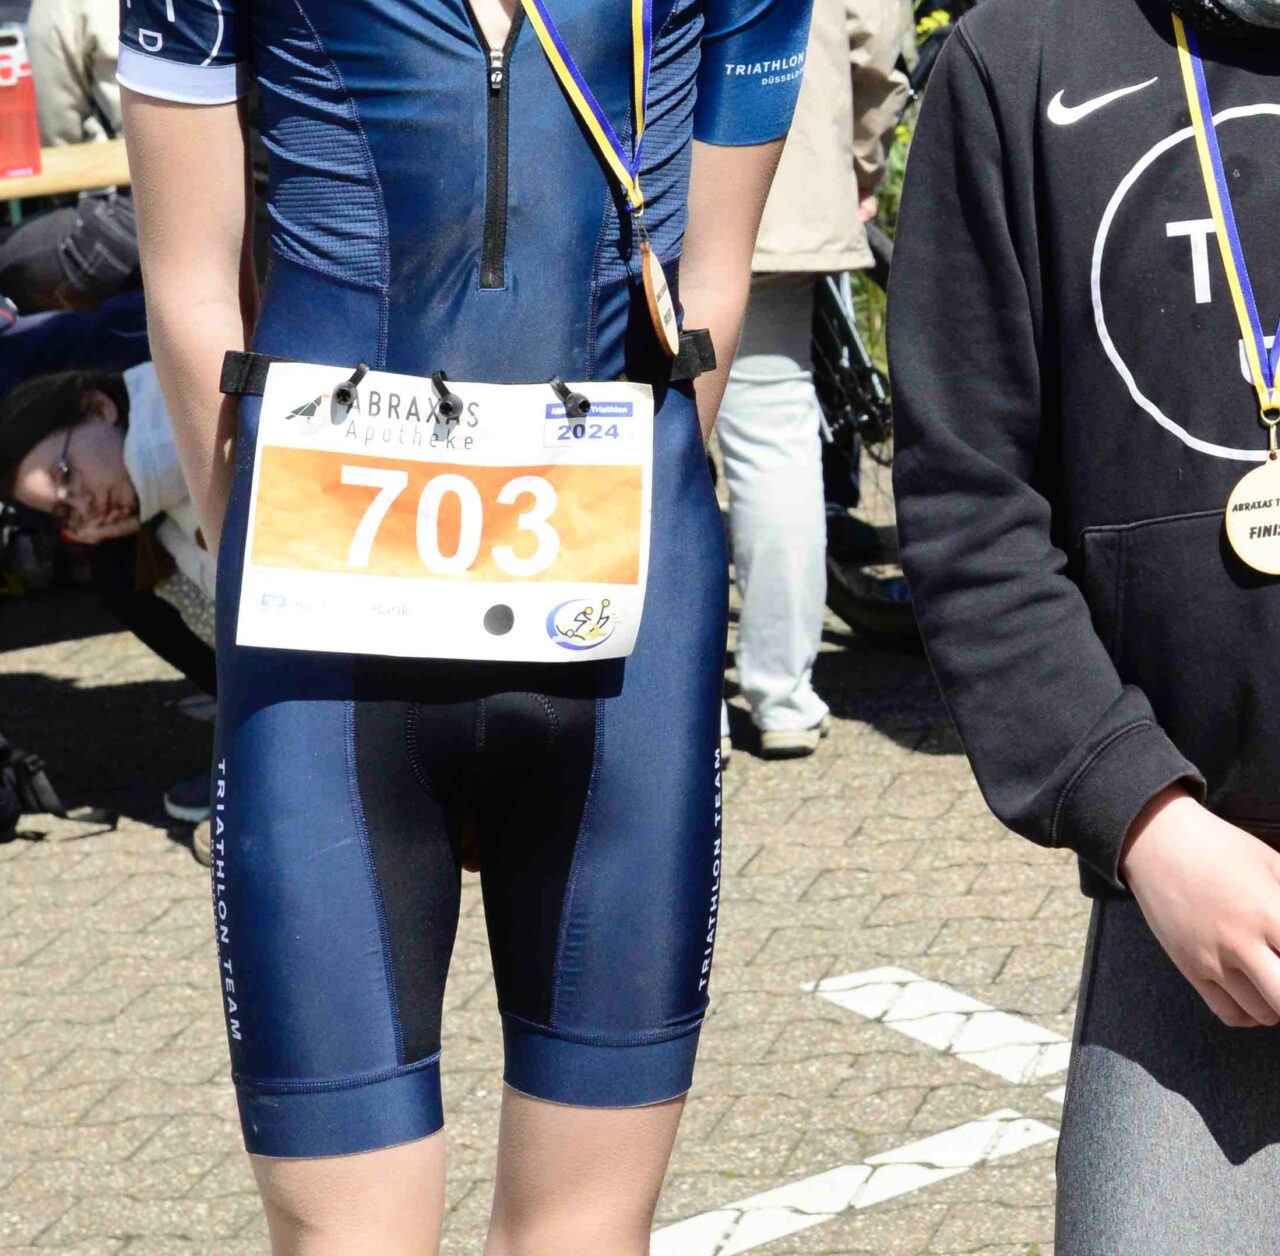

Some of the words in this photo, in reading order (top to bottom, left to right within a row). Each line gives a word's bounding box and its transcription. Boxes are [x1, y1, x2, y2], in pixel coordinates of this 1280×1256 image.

[725, 52, 805, 75] TRIATHLON
[345, 419, 475, 450] Apotheke
[557, 423, 620, 441] 2024
[340, 464, 562, 578] 703
[1232, 499, 1273, 512] ABRAXAS
[214, 758, 231, 945] TRIATHLON
[223, 958, 243, 1042] TEAM
[698, 838, 721, 993] TRIATHLON
